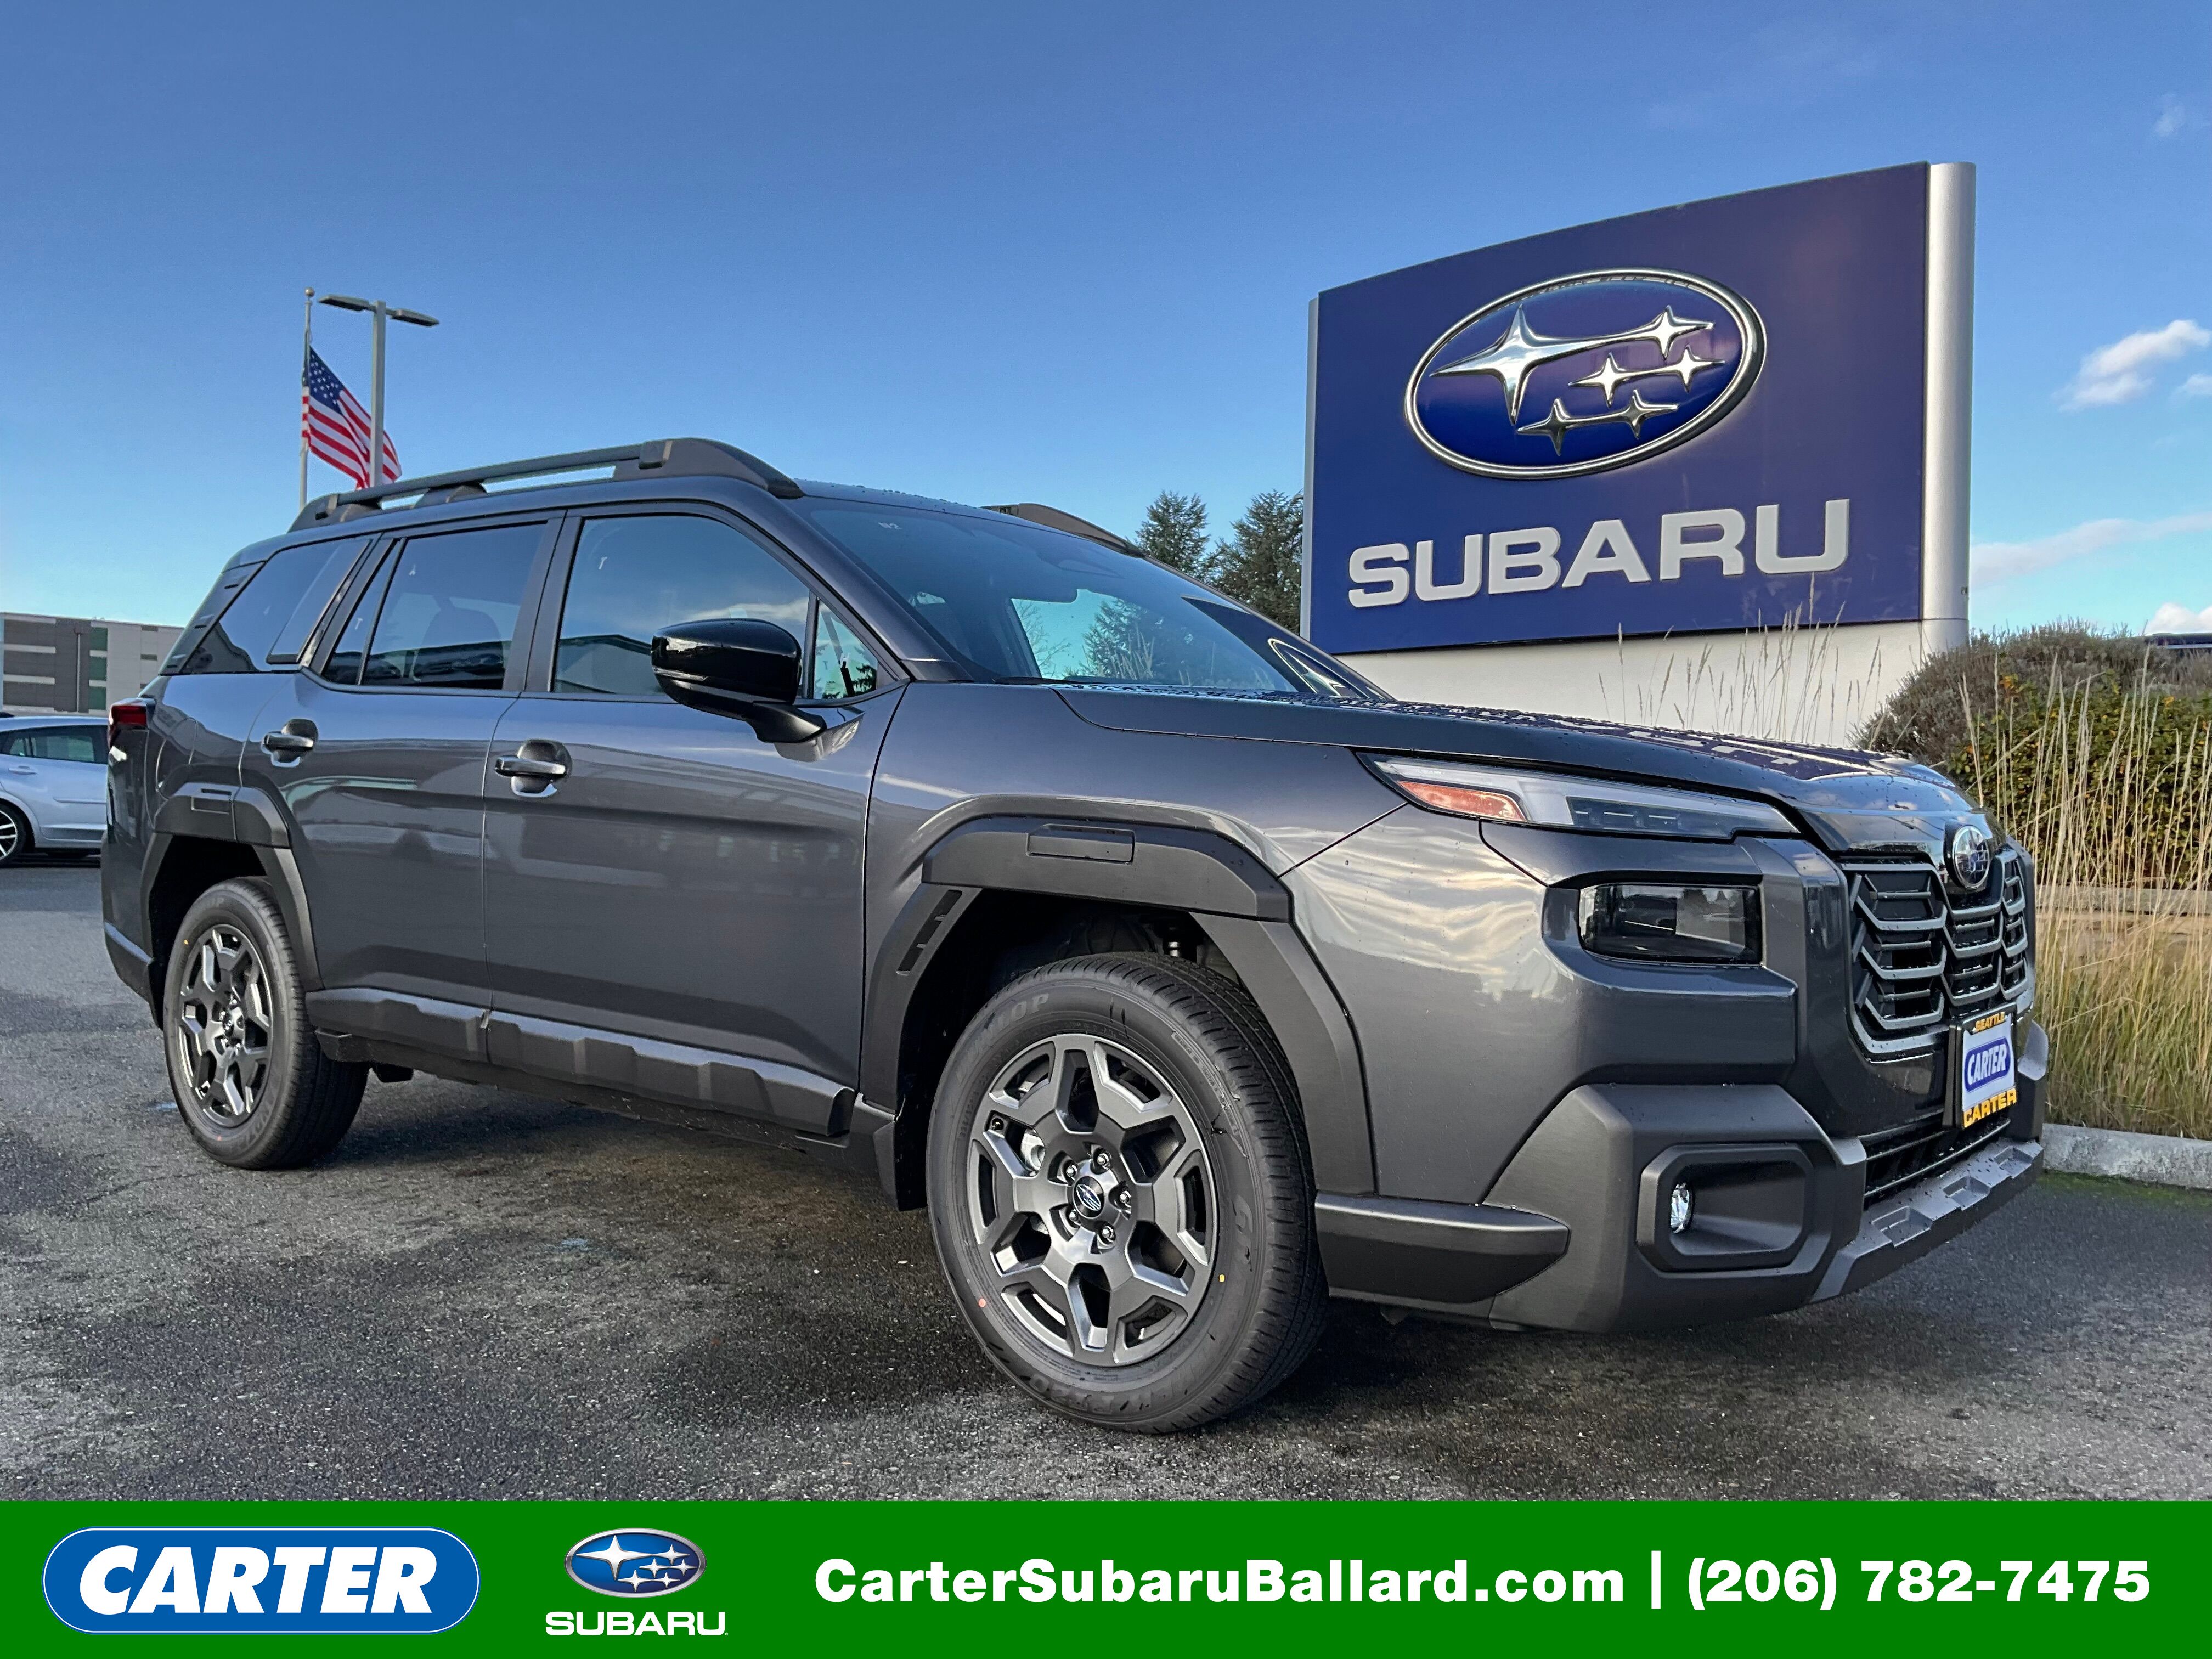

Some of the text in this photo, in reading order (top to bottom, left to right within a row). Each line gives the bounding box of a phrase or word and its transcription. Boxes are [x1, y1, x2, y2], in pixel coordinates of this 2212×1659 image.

[1348, 499, 1849, 608] SUBARU
[1975, 1011, 2005, 1032] SEATTLE
[1967, 1043, 2006, 1085] CARTER
[1963, 1088, 2017, 1128] CARTER
